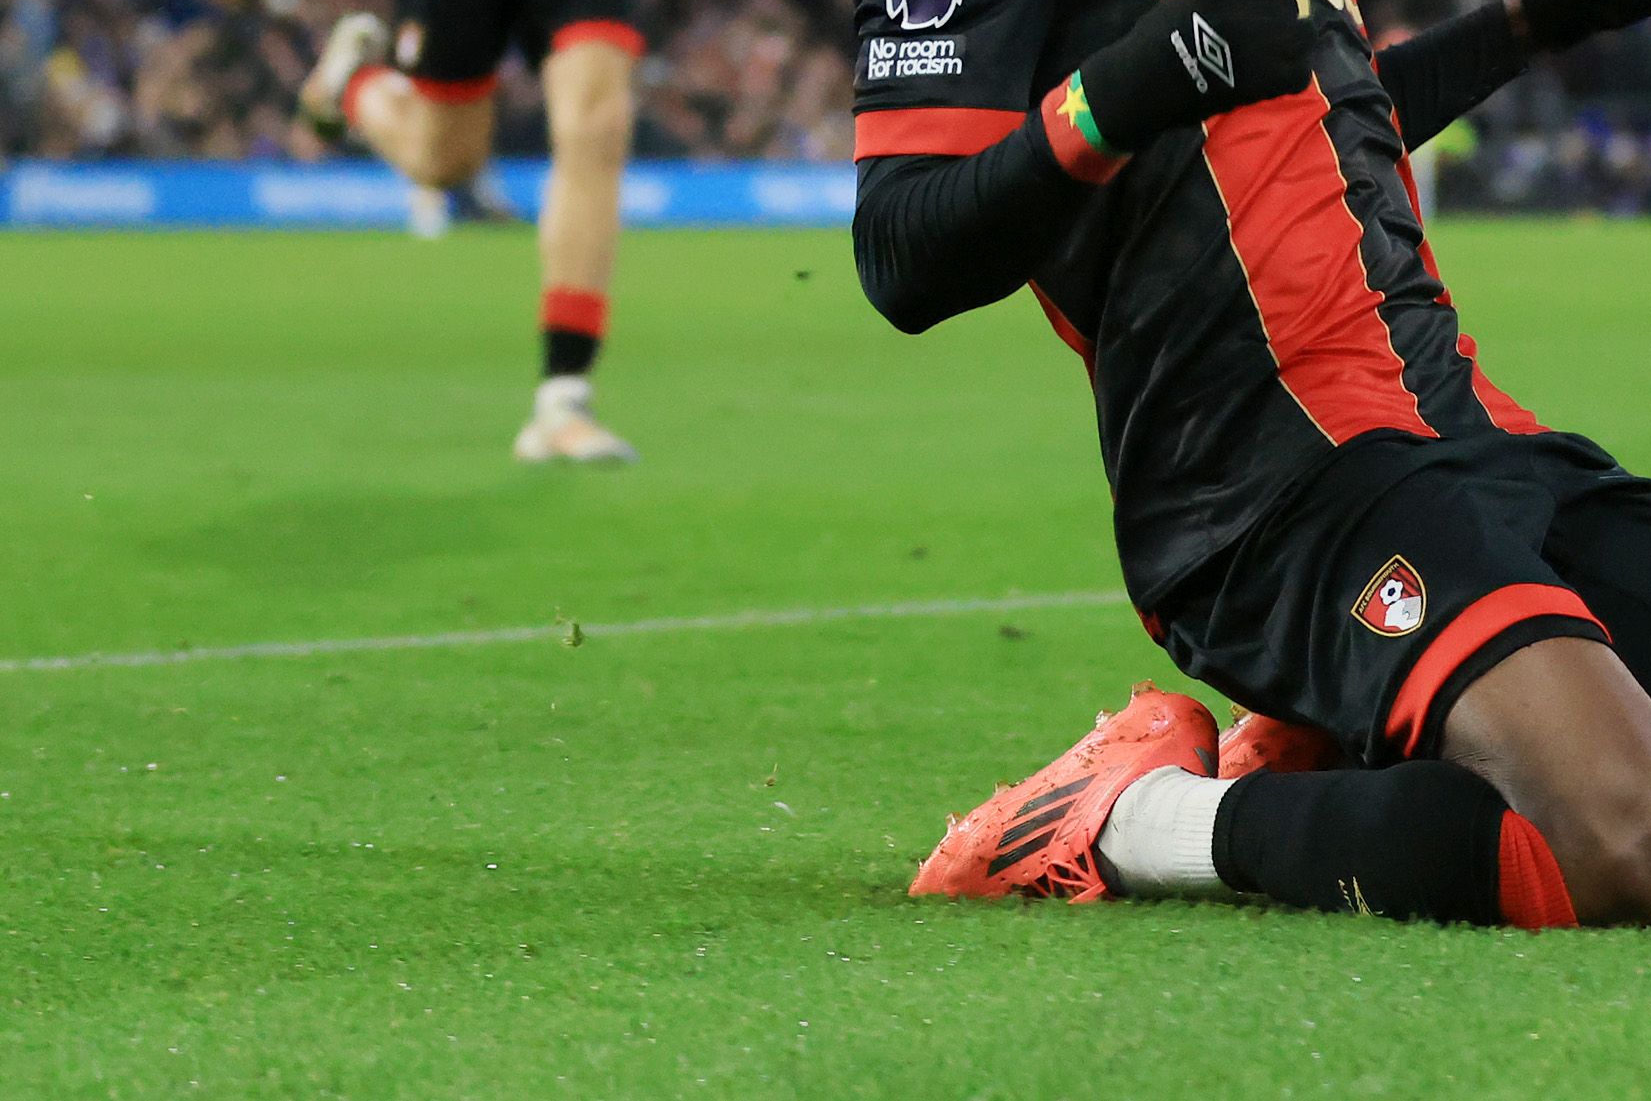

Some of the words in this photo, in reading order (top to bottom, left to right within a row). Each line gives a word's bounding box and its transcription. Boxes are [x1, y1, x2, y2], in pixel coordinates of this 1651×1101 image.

[868, 38, 897, 60] No
[899, 40, 955, 58] room
[868, 58, 895, 80] for
[896, 56, 963, 77] racism
